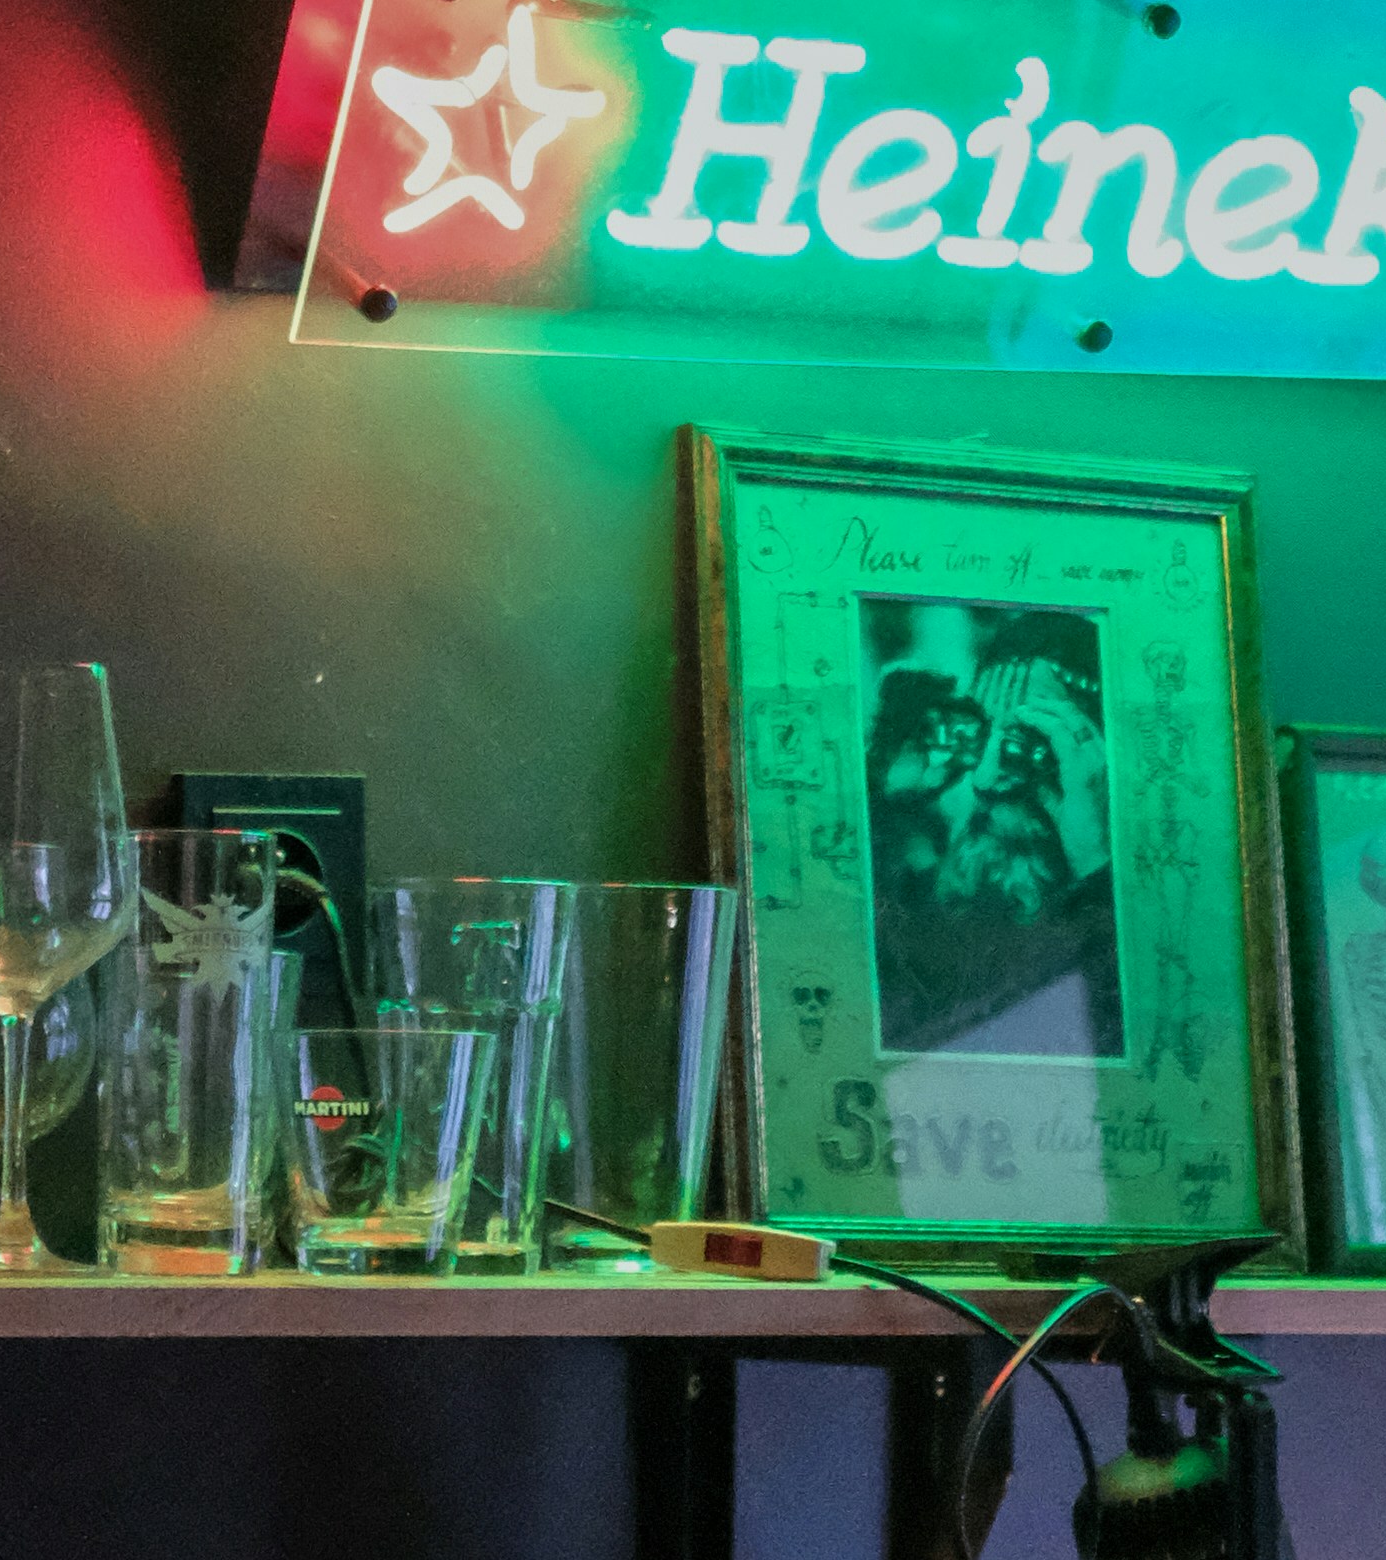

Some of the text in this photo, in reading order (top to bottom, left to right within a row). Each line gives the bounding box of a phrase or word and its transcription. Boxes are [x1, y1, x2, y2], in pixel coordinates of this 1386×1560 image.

[819, 515, 923, 574] Please
[294, 1101, 370, 1116] MARTINI
[817, 1075, 1022, 1183] Save
